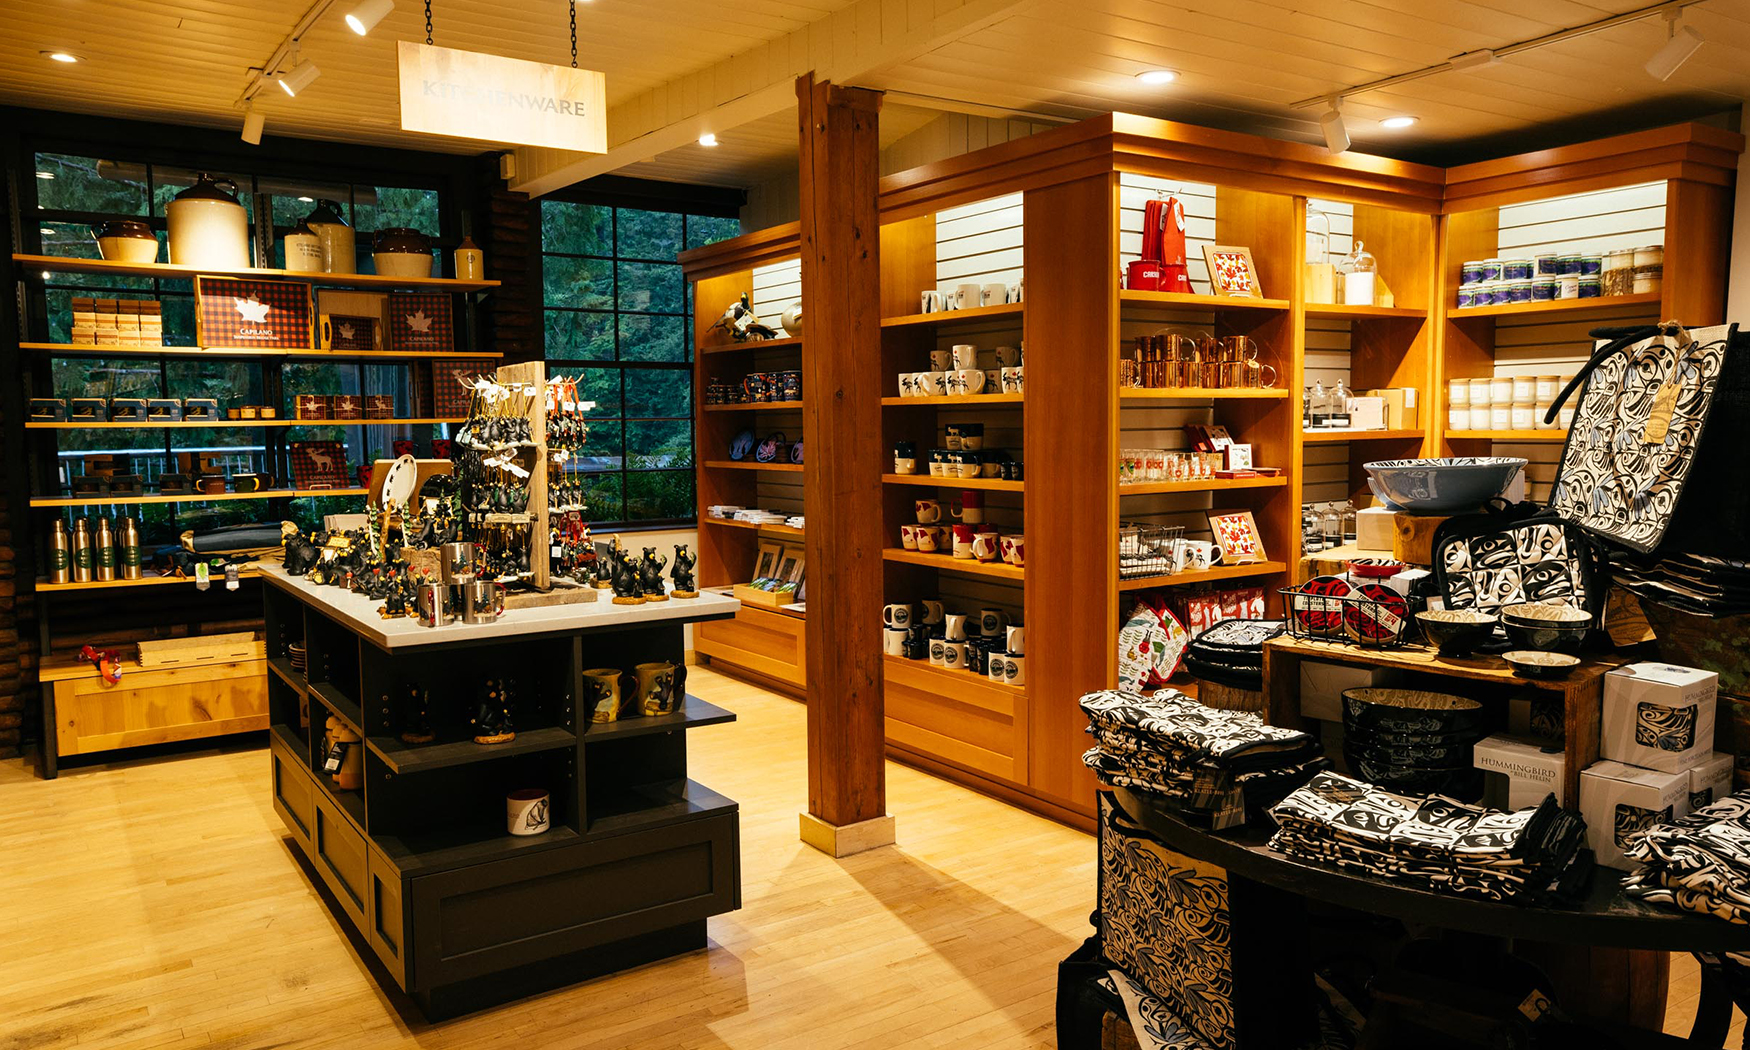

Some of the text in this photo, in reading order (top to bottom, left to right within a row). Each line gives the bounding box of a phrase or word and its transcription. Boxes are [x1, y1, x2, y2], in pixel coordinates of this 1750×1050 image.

[422, 80, 585, 117] KITCHENWARE
[240, 328, 273, 336] CAPILANO
[1481, 757, 1556, 778] HUMMINGBIRD
[1513, 770, 1527, 779] BILL
[1529, 773, 1551, 783] HELIN
